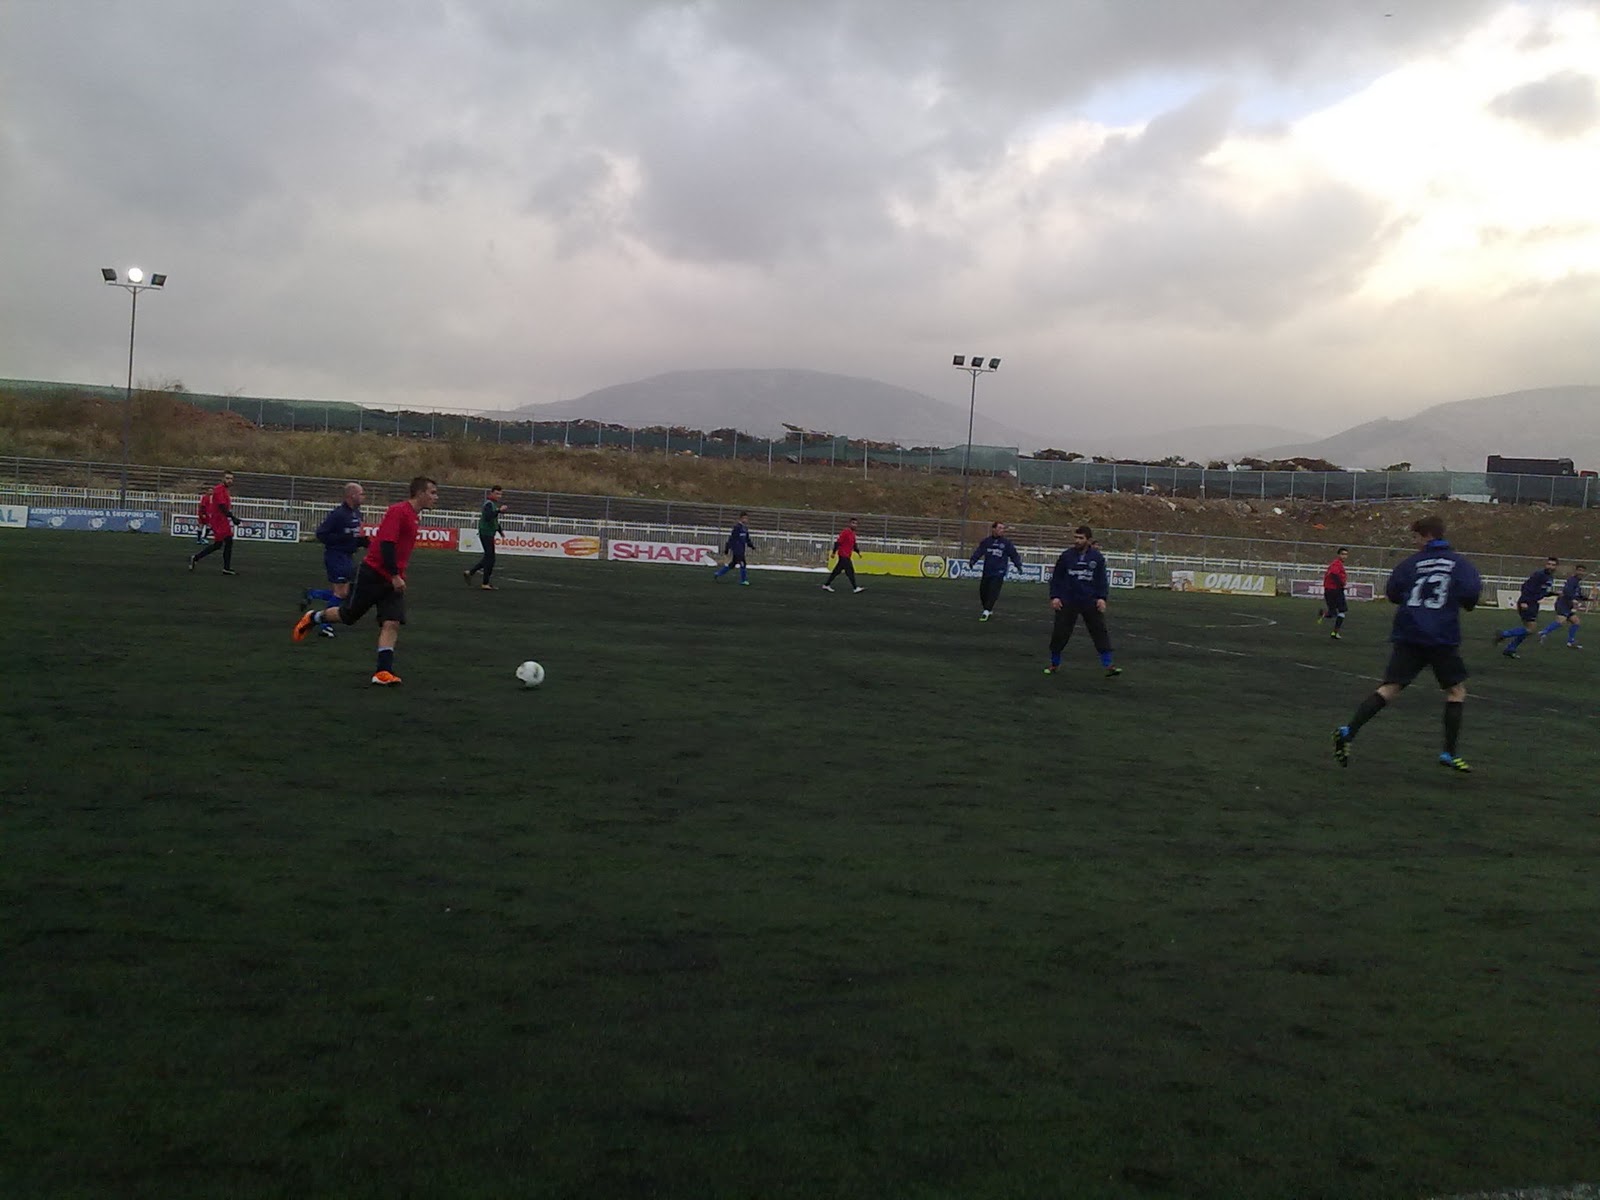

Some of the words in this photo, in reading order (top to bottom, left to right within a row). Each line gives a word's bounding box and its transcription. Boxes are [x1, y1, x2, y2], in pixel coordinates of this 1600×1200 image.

[238, 527, 262, 538] 89.2
[269, 529, 293, 539] 89.2
[613, 543, 712, 562] SHARP
[1407, 573, 1451, 609] 13
